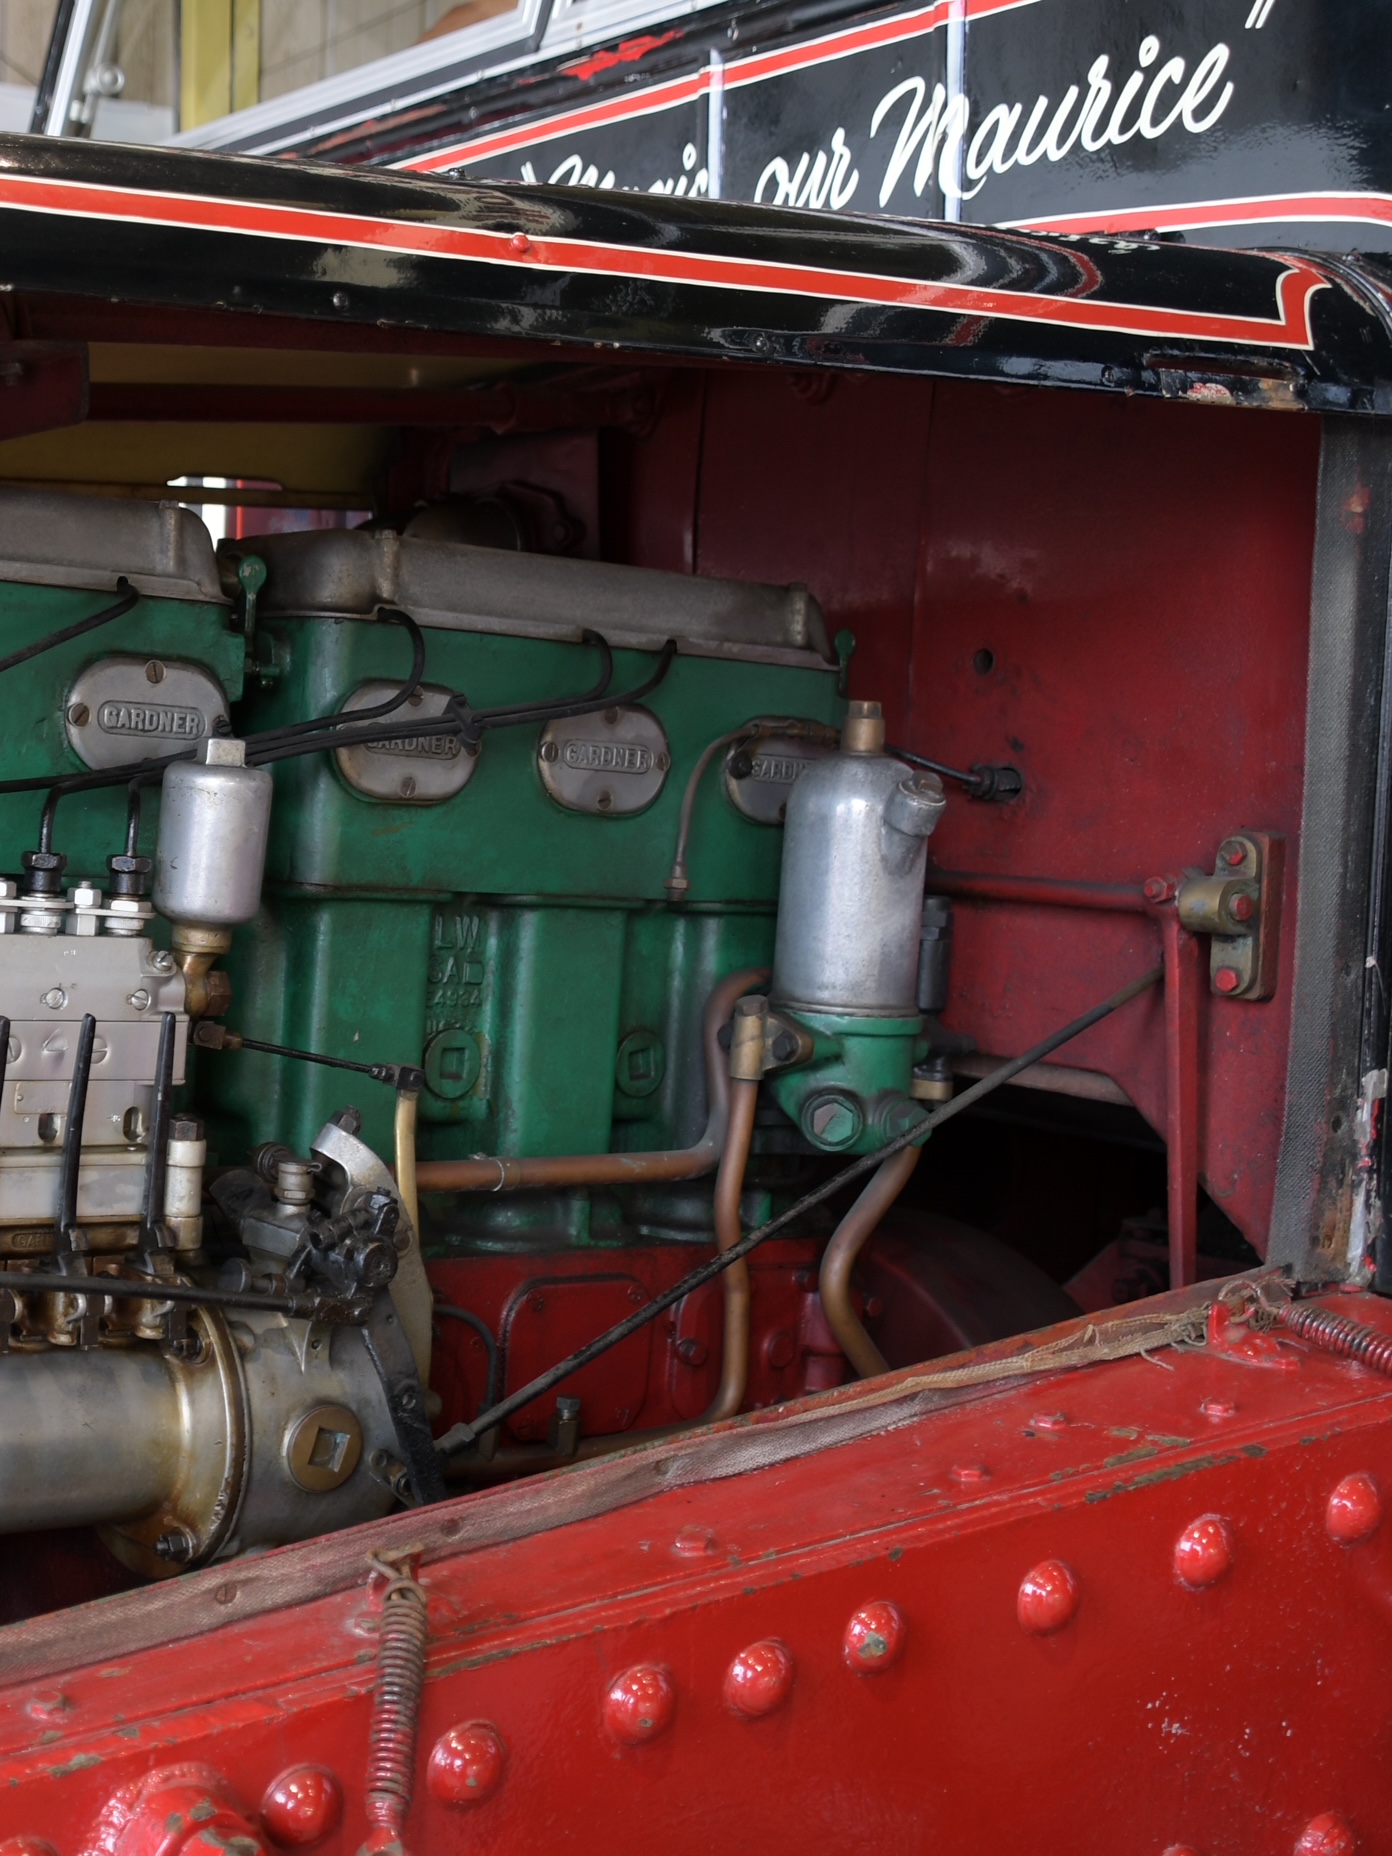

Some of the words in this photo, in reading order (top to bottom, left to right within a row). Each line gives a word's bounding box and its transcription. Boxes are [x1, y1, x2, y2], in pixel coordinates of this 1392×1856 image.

[104, 705, 200, 735] GARDNER
[566, 743, 648, 769] GARDNER
[434, 915, 480, 954] LW
